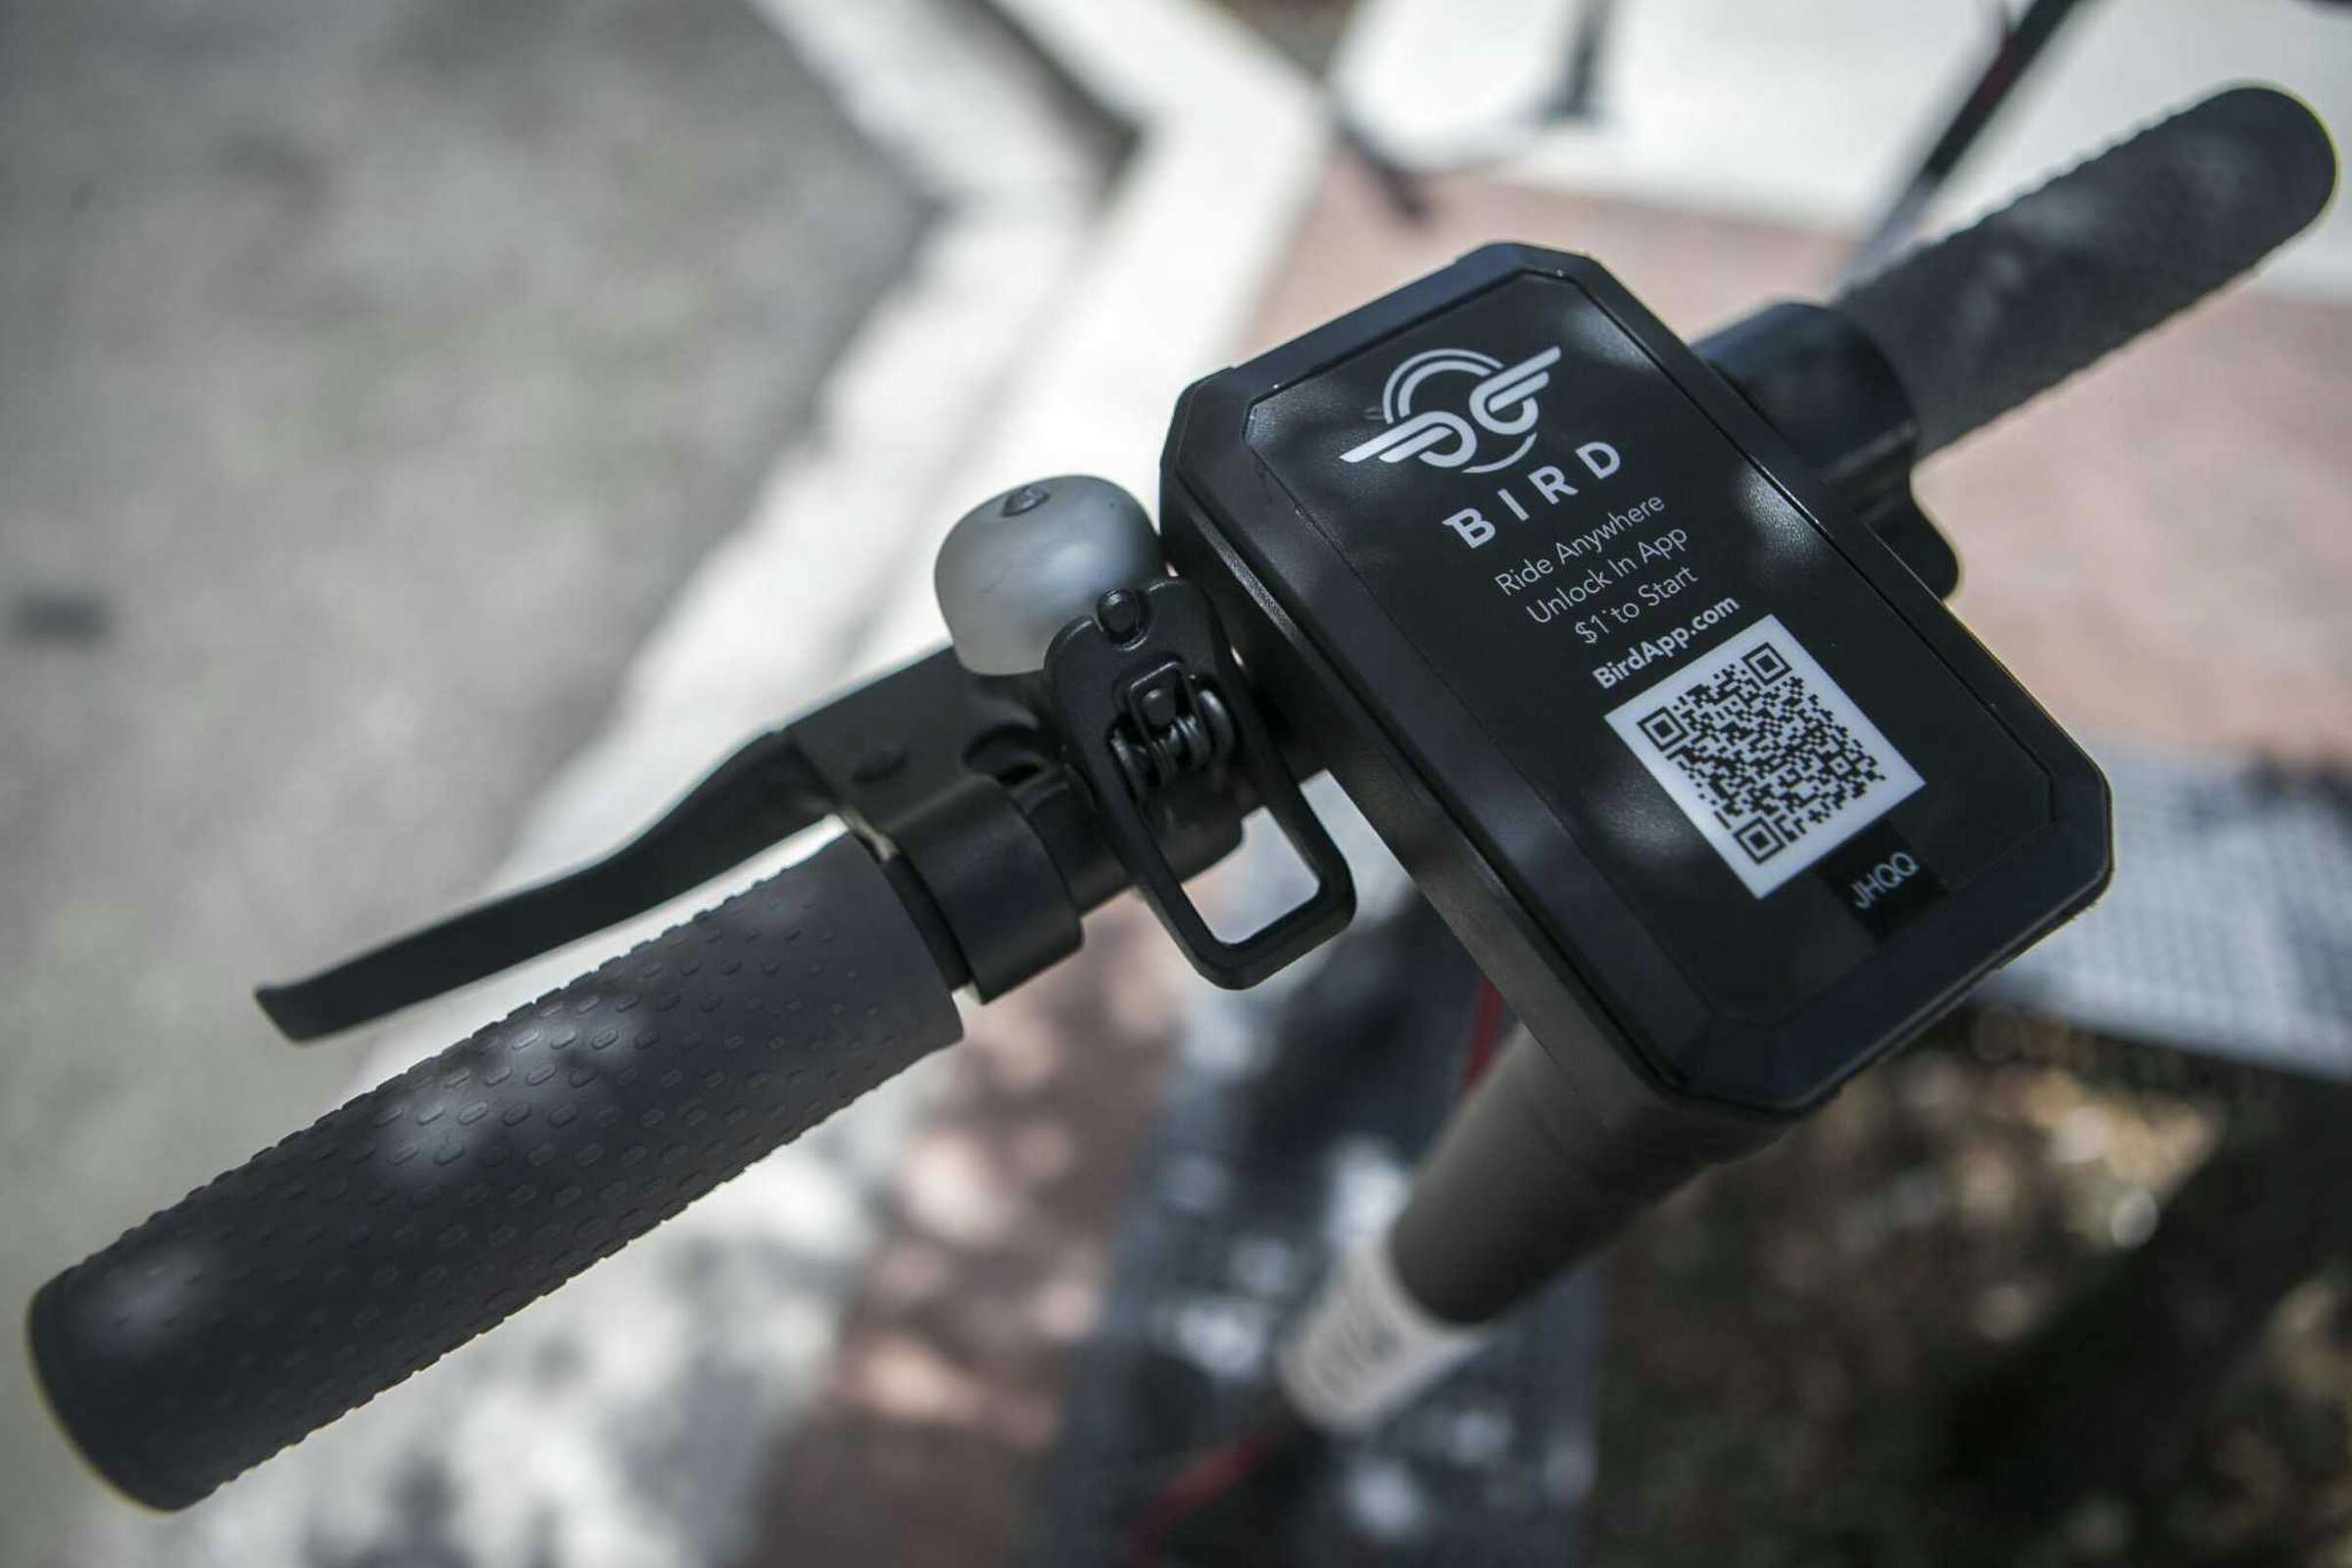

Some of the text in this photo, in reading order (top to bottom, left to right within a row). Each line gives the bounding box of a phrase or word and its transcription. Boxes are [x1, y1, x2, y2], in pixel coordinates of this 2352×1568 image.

[1443, 441, 1621, 549] BIRD
[1494, 496, 1665, 596] Ride Anywhere
[1525, 528, 1688, 623] Unlock In App
[1575, 565, 1698, 644] $1 to Start
[1592, 596, 1740, 689] BirdApp.com
[1851, 852, 1919, 909] JHQQ
